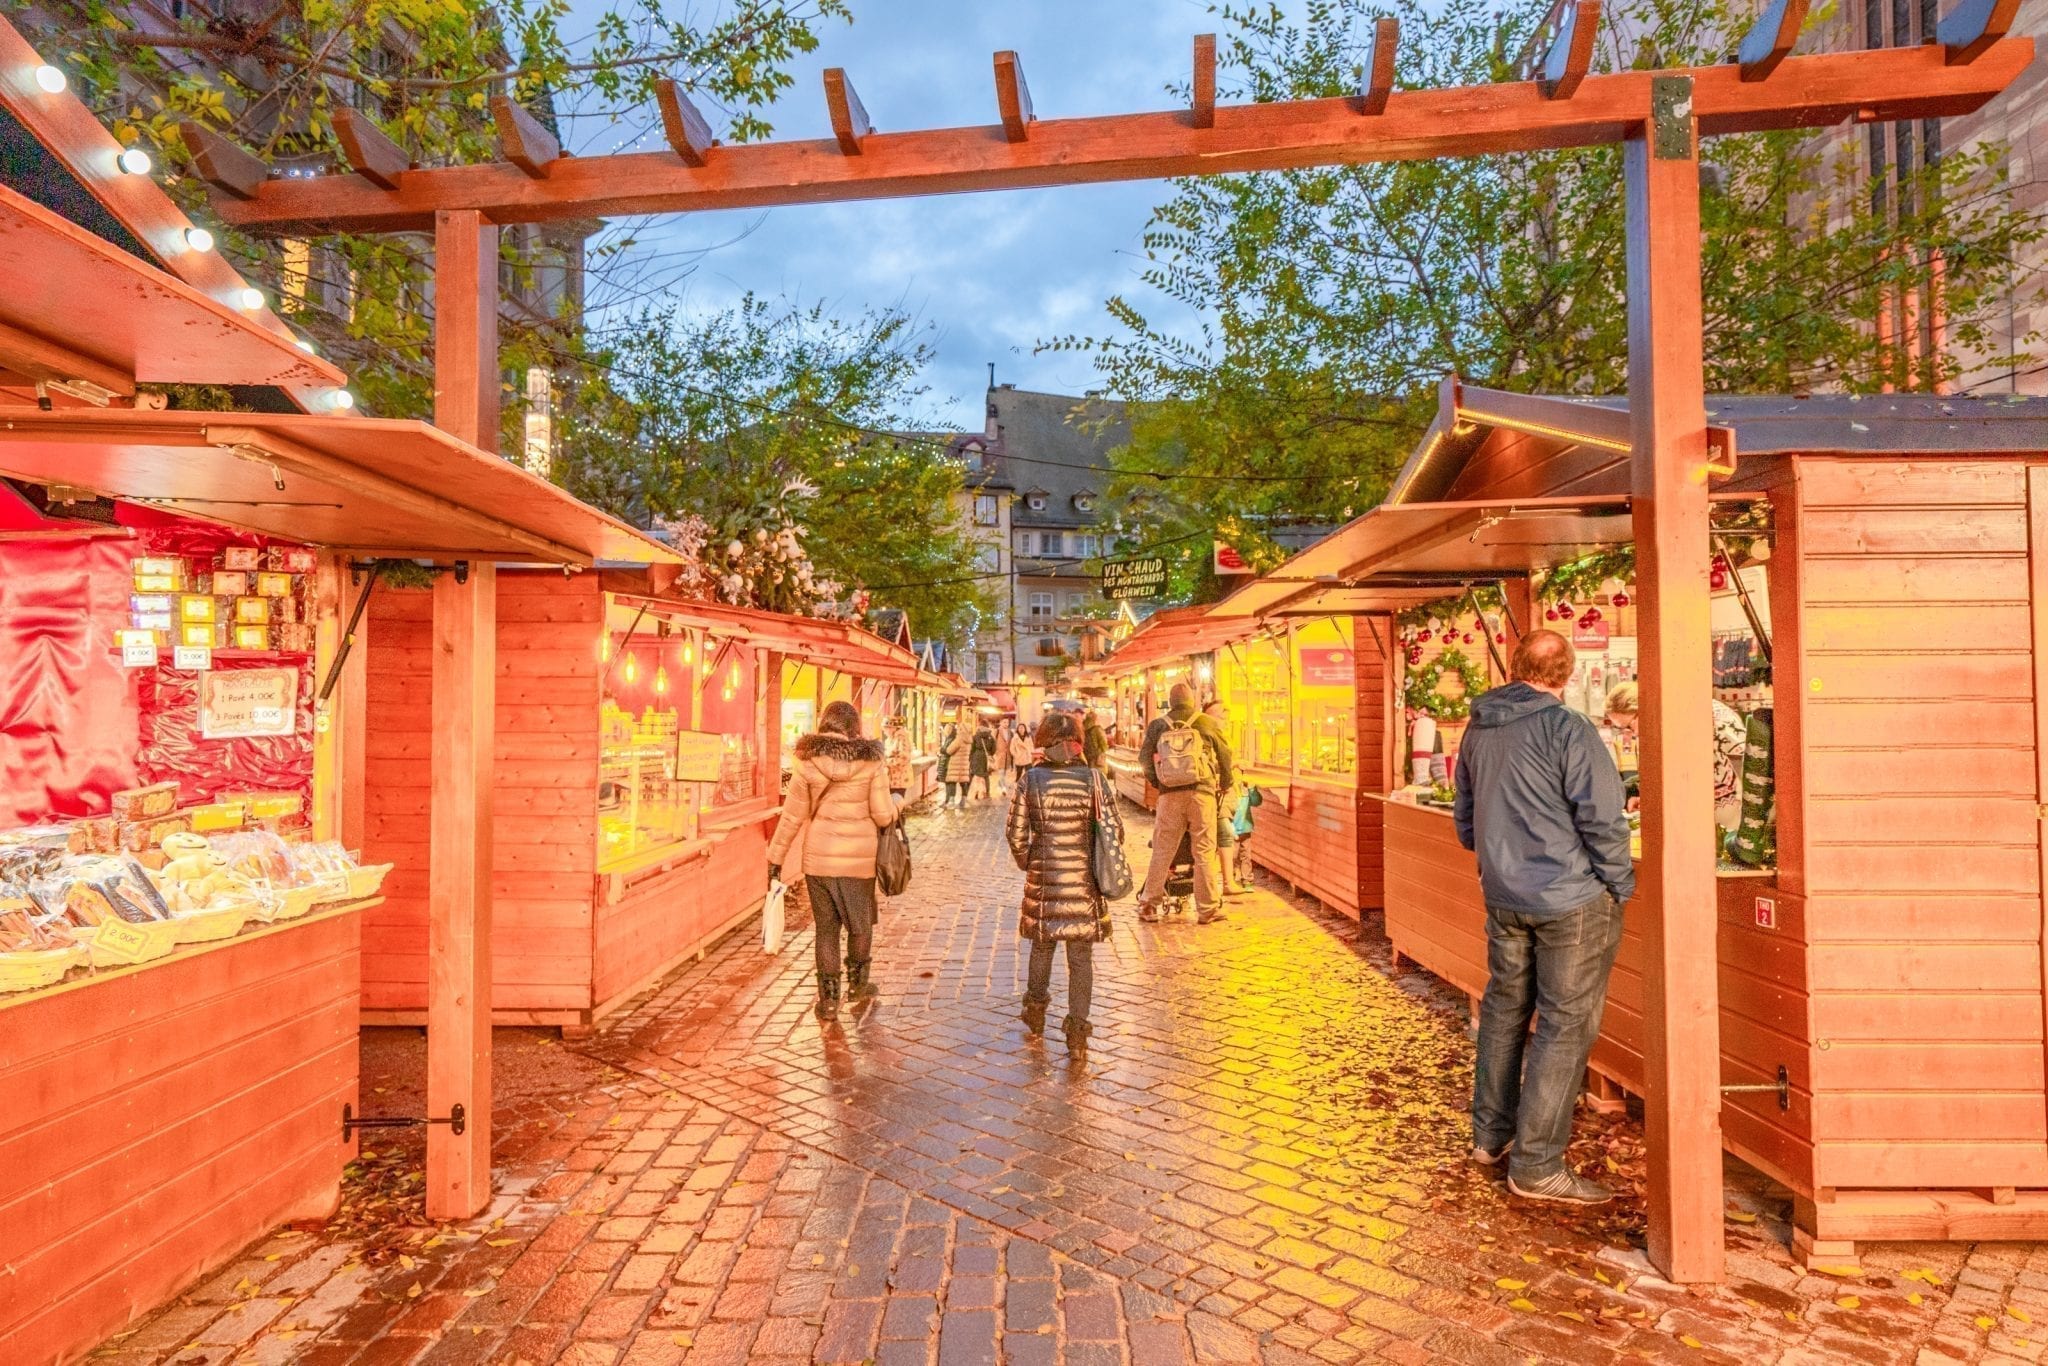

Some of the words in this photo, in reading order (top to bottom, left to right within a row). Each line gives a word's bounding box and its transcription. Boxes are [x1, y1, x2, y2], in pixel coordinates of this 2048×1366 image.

[1104, 563, 1124, 578] VIN
[1127, 558, 1163, 575] CHAUD
[1103, 576, 1116, 588] DES
[1116, 571, 1166, 587] MONTAGNARDS
